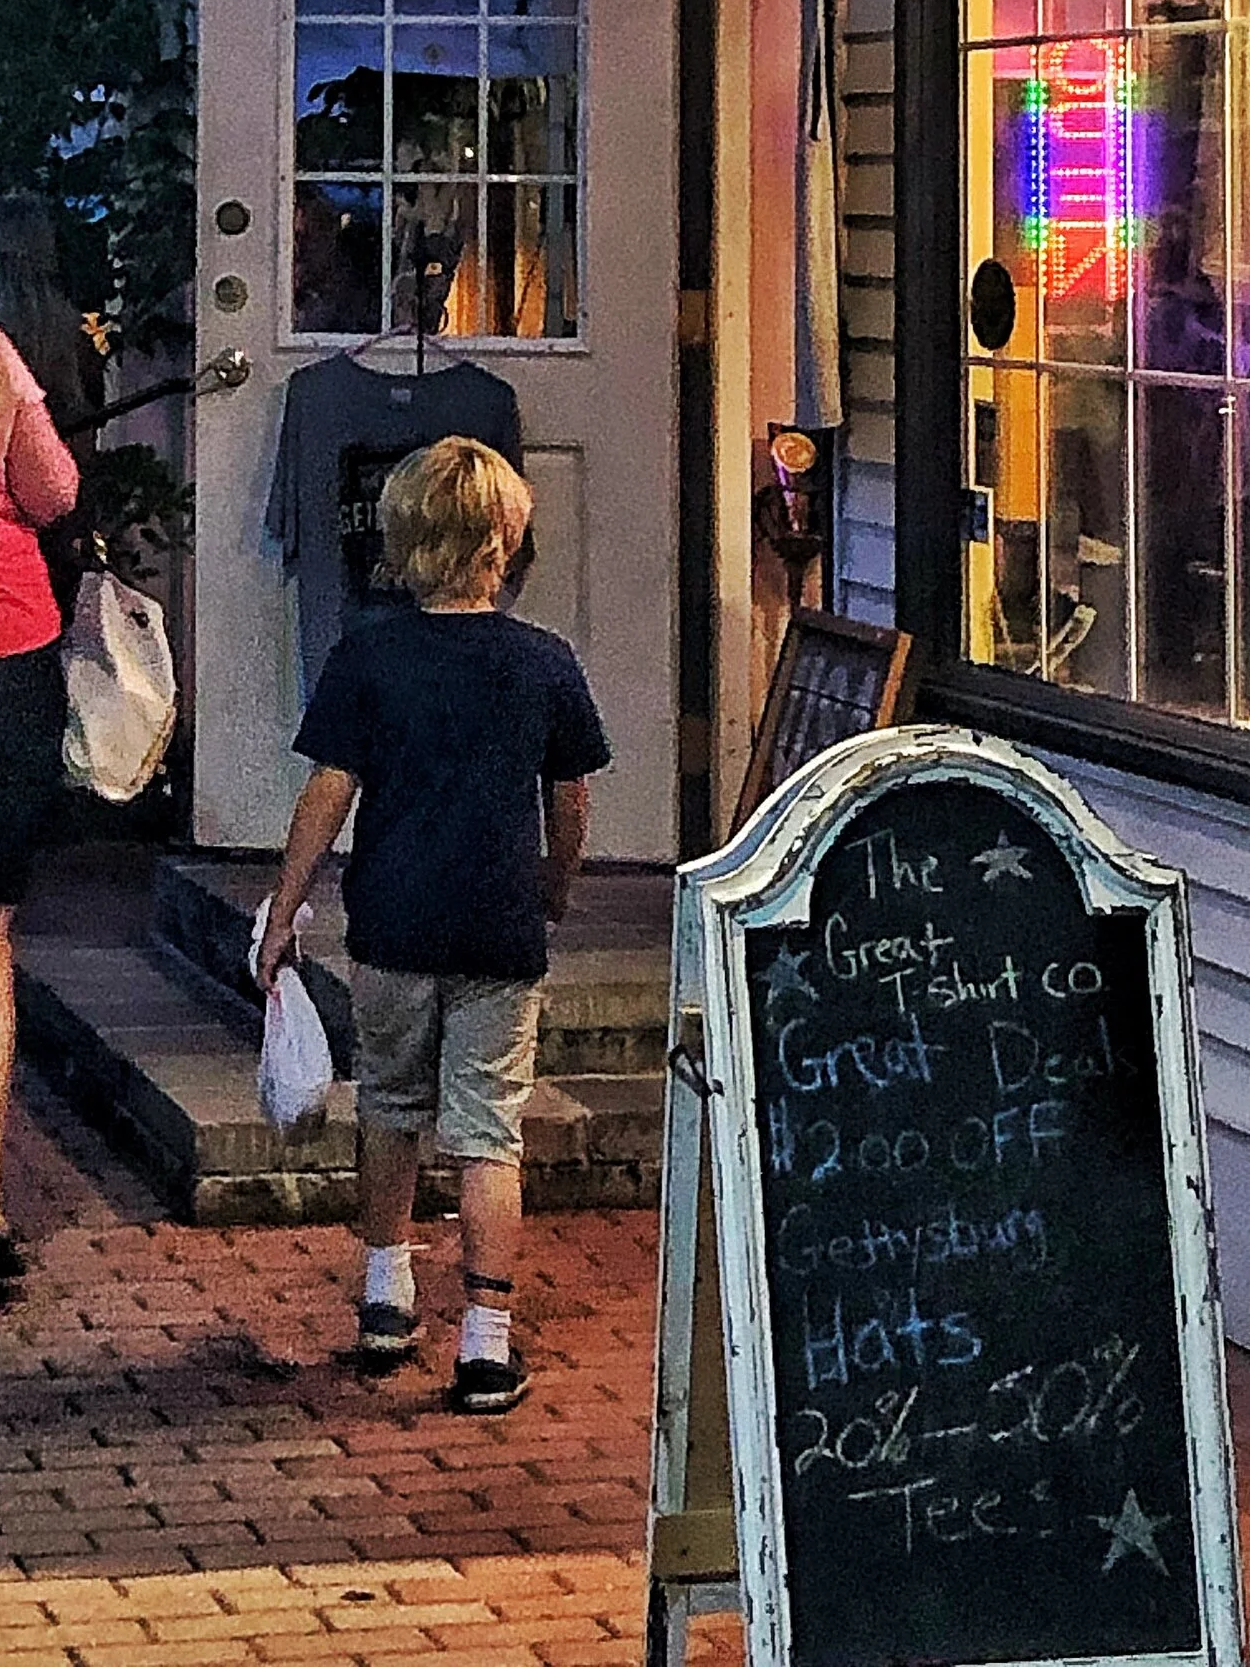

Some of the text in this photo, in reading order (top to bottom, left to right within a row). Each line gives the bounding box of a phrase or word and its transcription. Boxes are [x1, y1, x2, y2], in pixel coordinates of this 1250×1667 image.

[845, 830, 943, 899] The
[825, 912, 954, 980] Great
[779, 1012, 947, 1091] Great
[951, 1100, 1070, 1169] OFF
[803, 1288, 982, 1390] Hats
[794, 1385, 920, 1476] 20%
